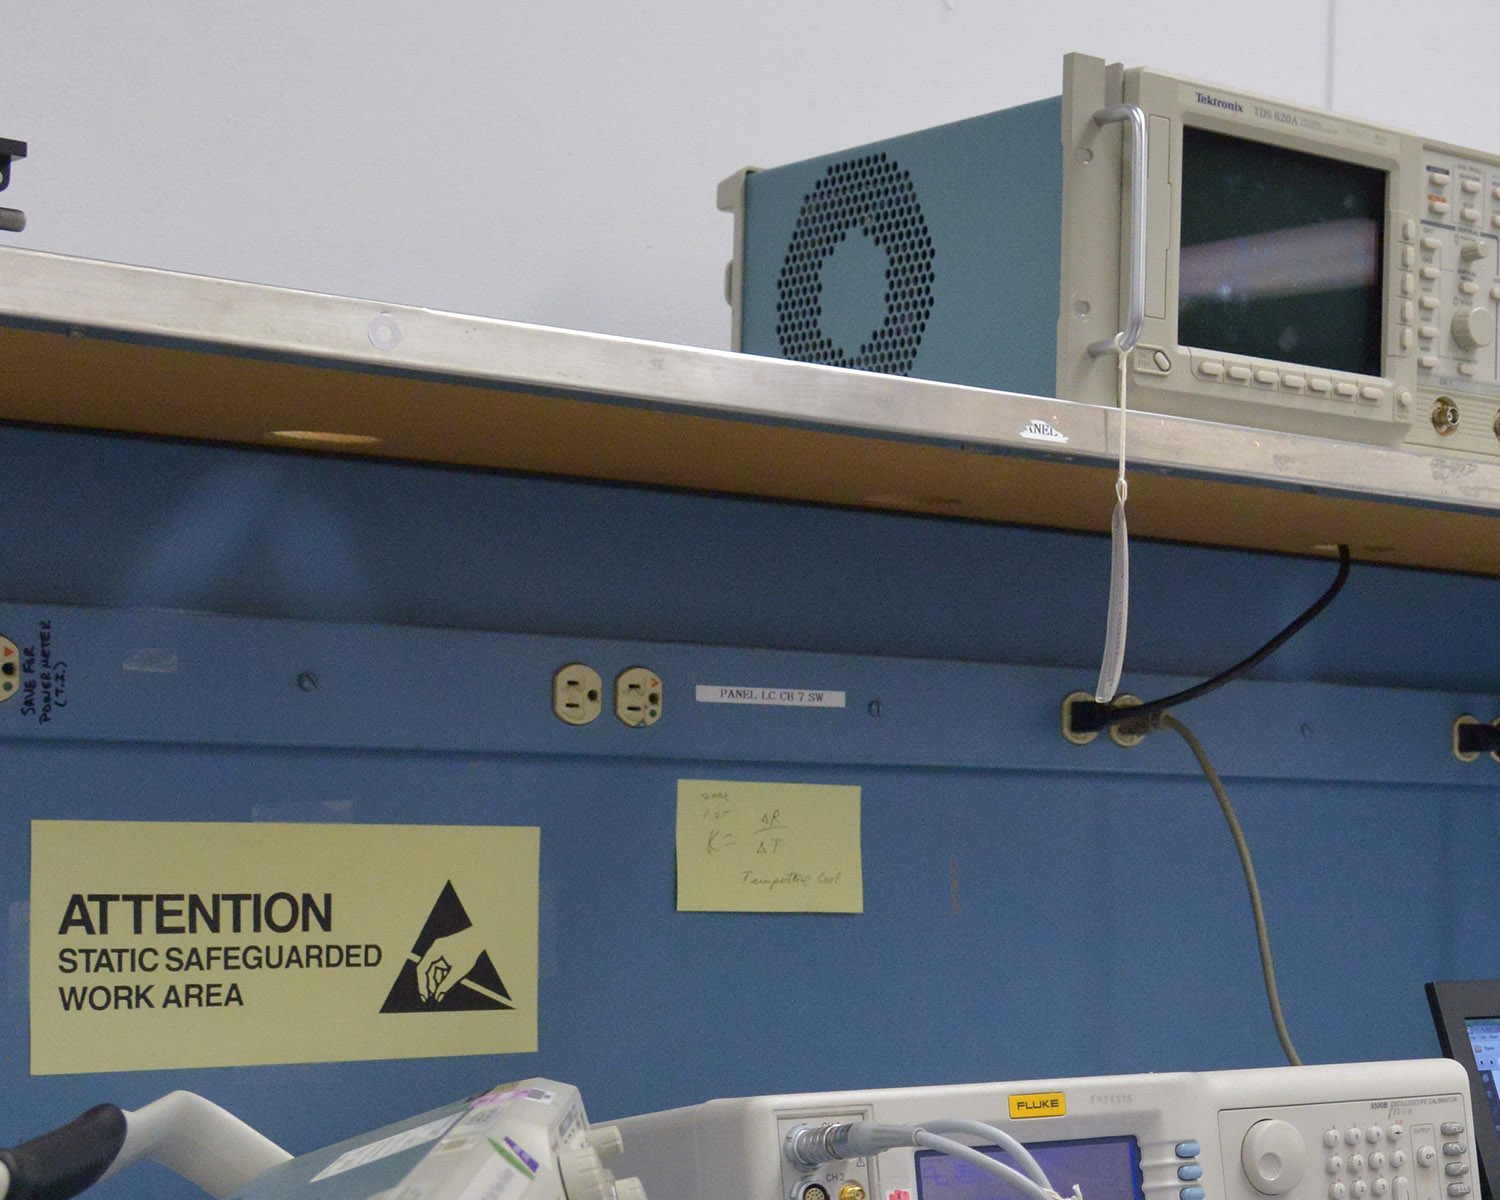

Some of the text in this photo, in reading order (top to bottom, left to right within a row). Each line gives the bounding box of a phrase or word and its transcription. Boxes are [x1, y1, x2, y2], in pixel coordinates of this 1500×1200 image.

[1195, 92, 1298, 126] Tektronix TDS 620A
[39, 620, 52, 725] POWER METER
[21, 680, 36, 716] SAVE
[720, 689, 824, 702] PANEL LC CB 7 SW
[58, 892, 332, 935] ATTENTION
[58, 944, 382, 973] STATIC SAFEGUARDED
[58, 983, 244, 1011] WORK AREA
[1017, 1099, 1059, 1110] FLUKE
[826, 1174, 838, 1182] CH
